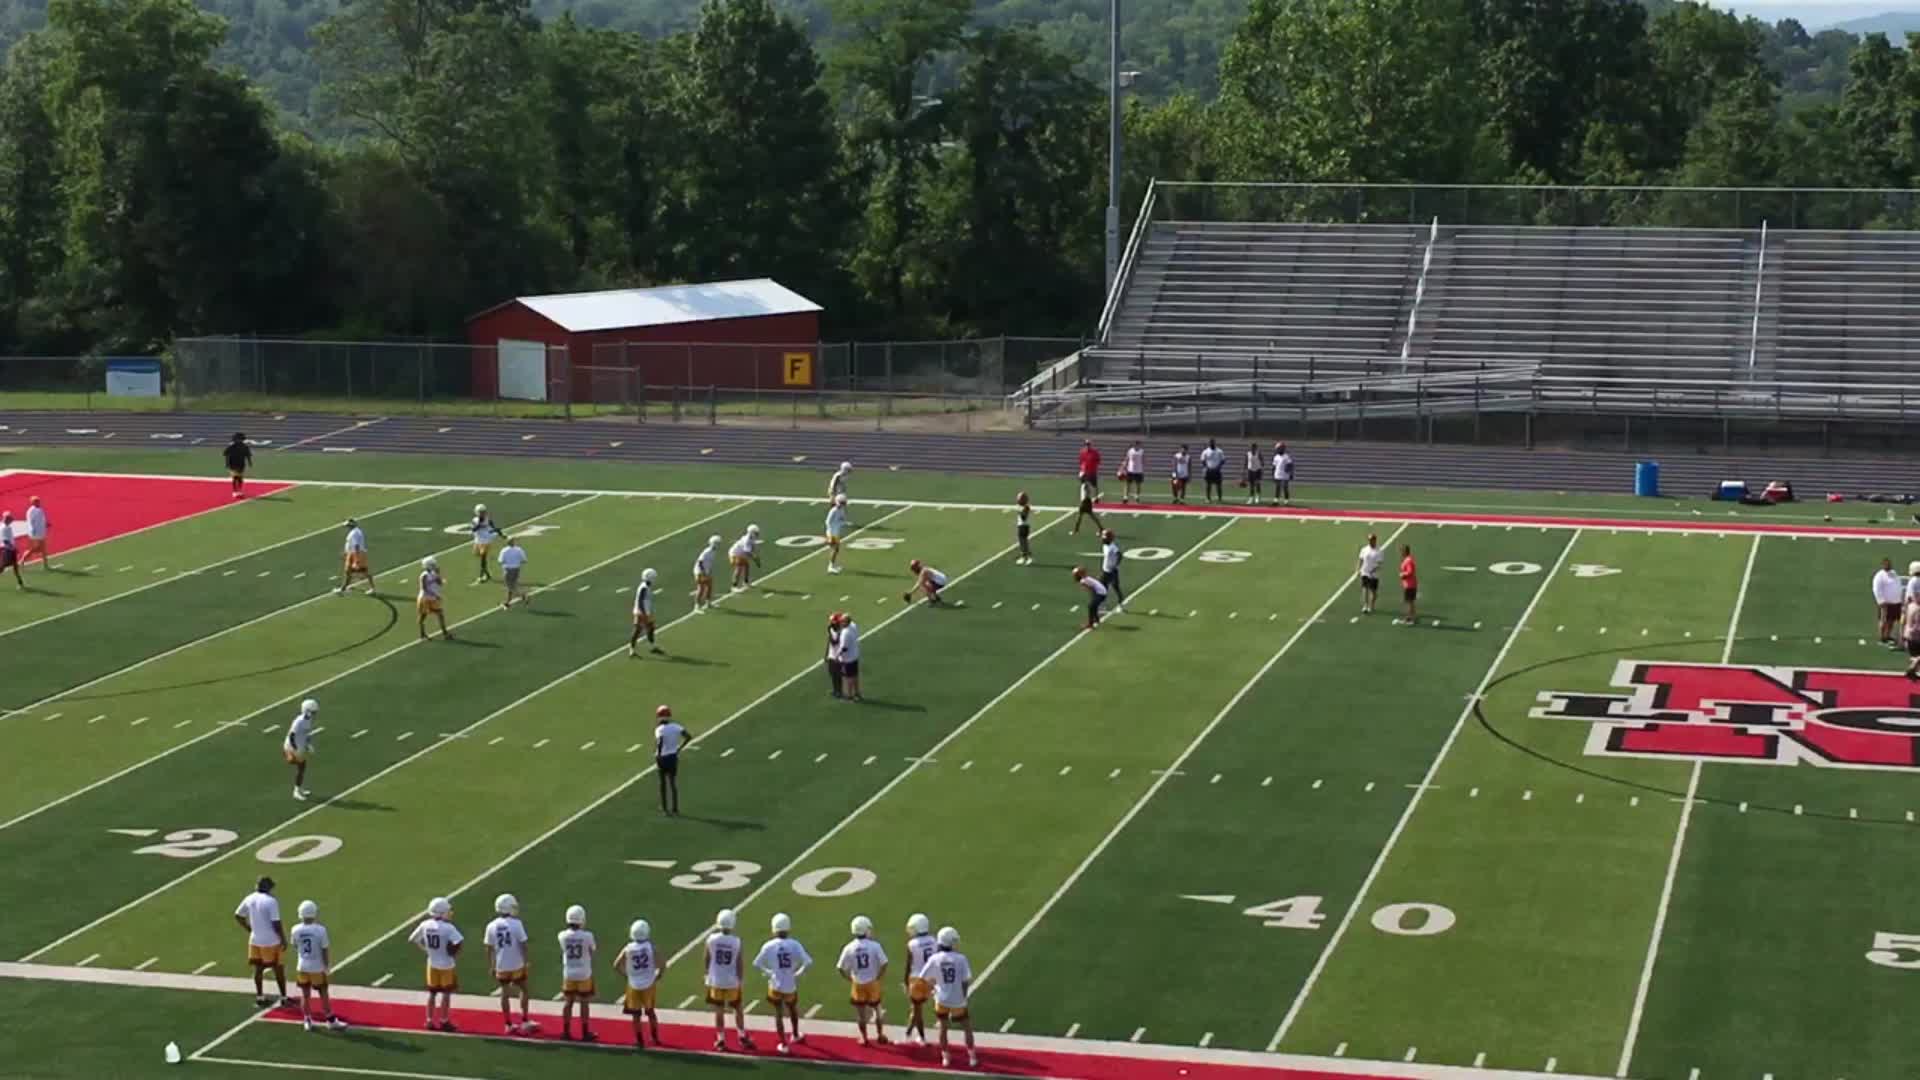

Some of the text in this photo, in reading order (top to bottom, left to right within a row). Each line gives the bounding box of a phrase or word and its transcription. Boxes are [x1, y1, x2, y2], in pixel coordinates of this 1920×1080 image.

[789, 358, 804, 380] F
[302, 938, 312, 954] 3
[425, 933, 441, 949] 10
[632, 953, 649, 970] 32
[777, 953, 792, 968] 15
